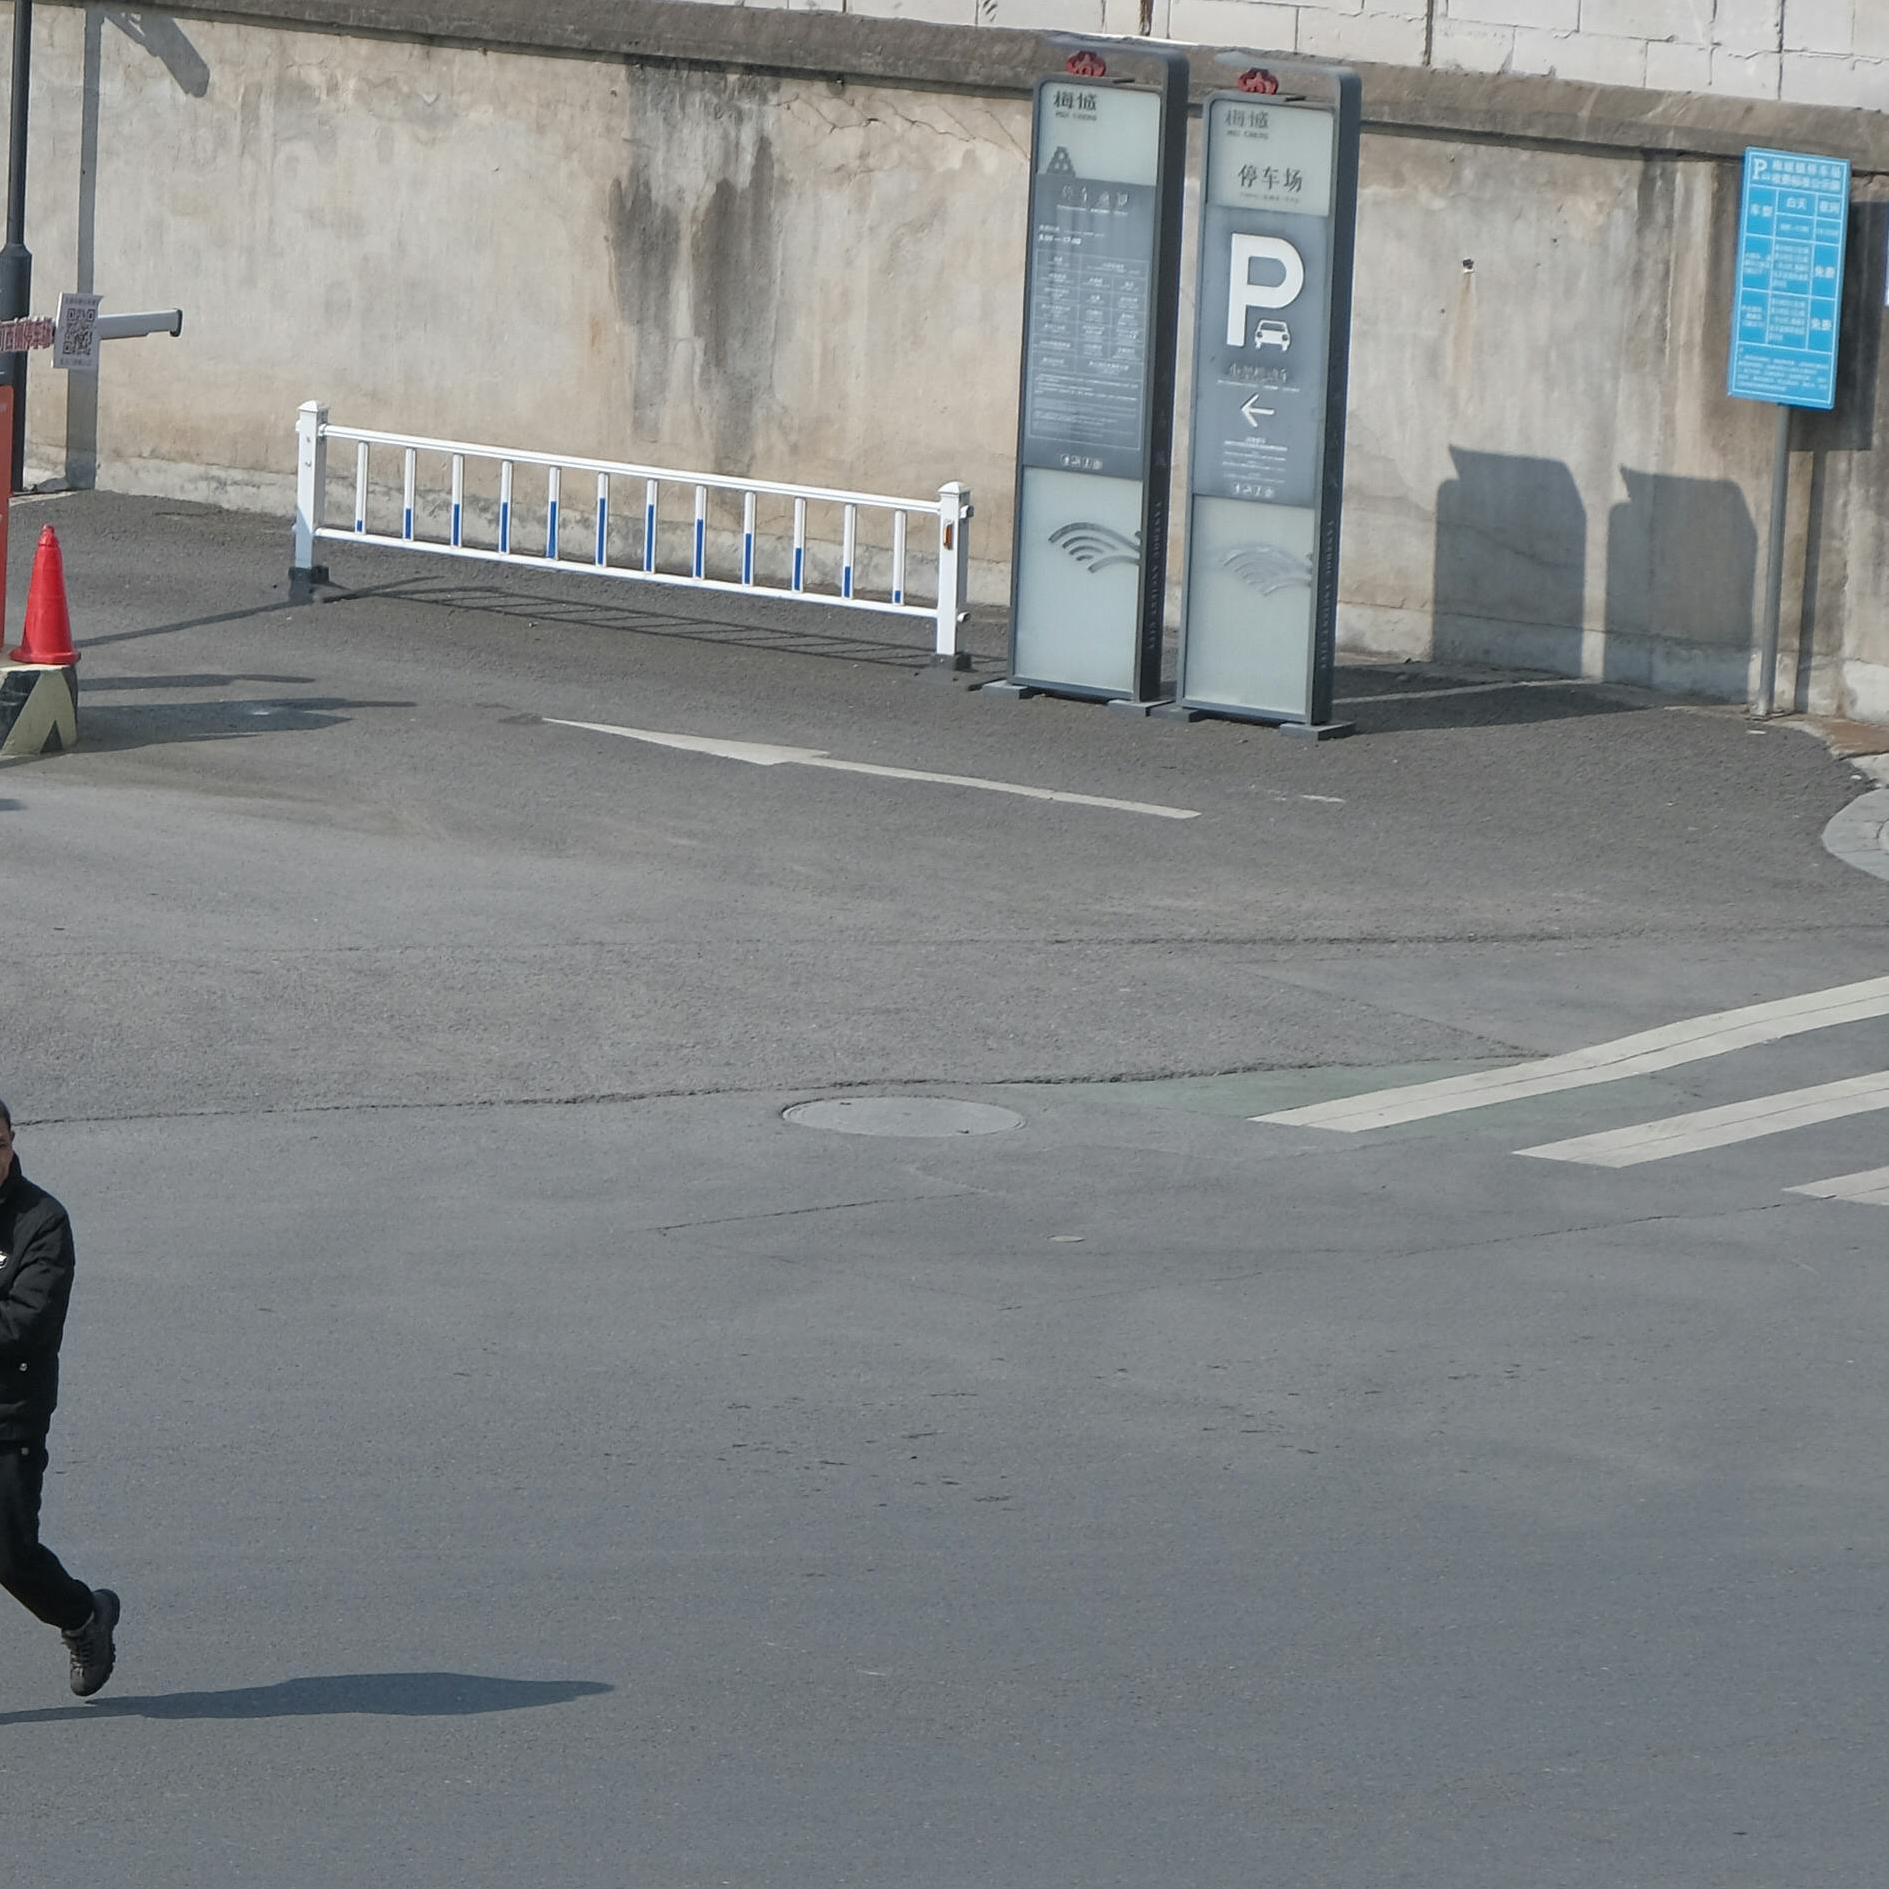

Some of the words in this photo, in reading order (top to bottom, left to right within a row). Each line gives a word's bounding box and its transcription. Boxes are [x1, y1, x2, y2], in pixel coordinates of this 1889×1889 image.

[1238, 164, 1304, 193] 停车场
[1752, 158, 1768, 180] P
[1226, 232, 1306, 348] P
